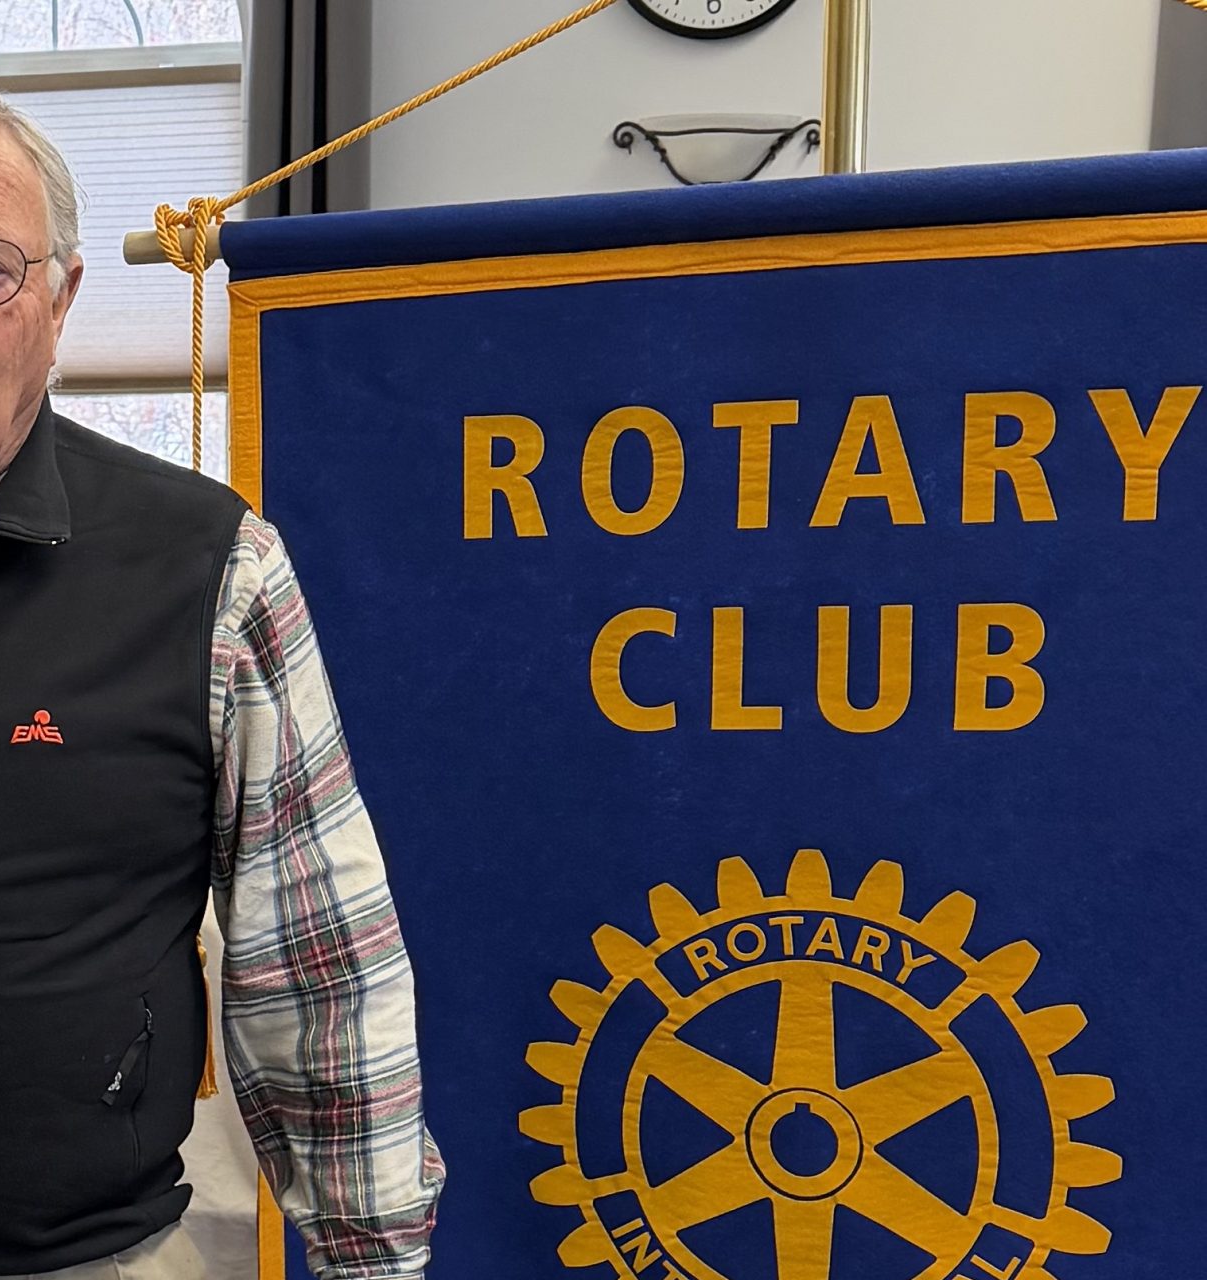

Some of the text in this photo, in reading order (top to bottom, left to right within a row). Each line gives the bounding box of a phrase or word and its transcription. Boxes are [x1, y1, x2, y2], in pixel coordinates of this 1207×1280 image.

[463, 385, 1202, 540] ROTARY
[589, 602, 1046, 734] CLUB
[10, 724, 64, 744] EMS
[682, 915, 935, 984] ROTARY
